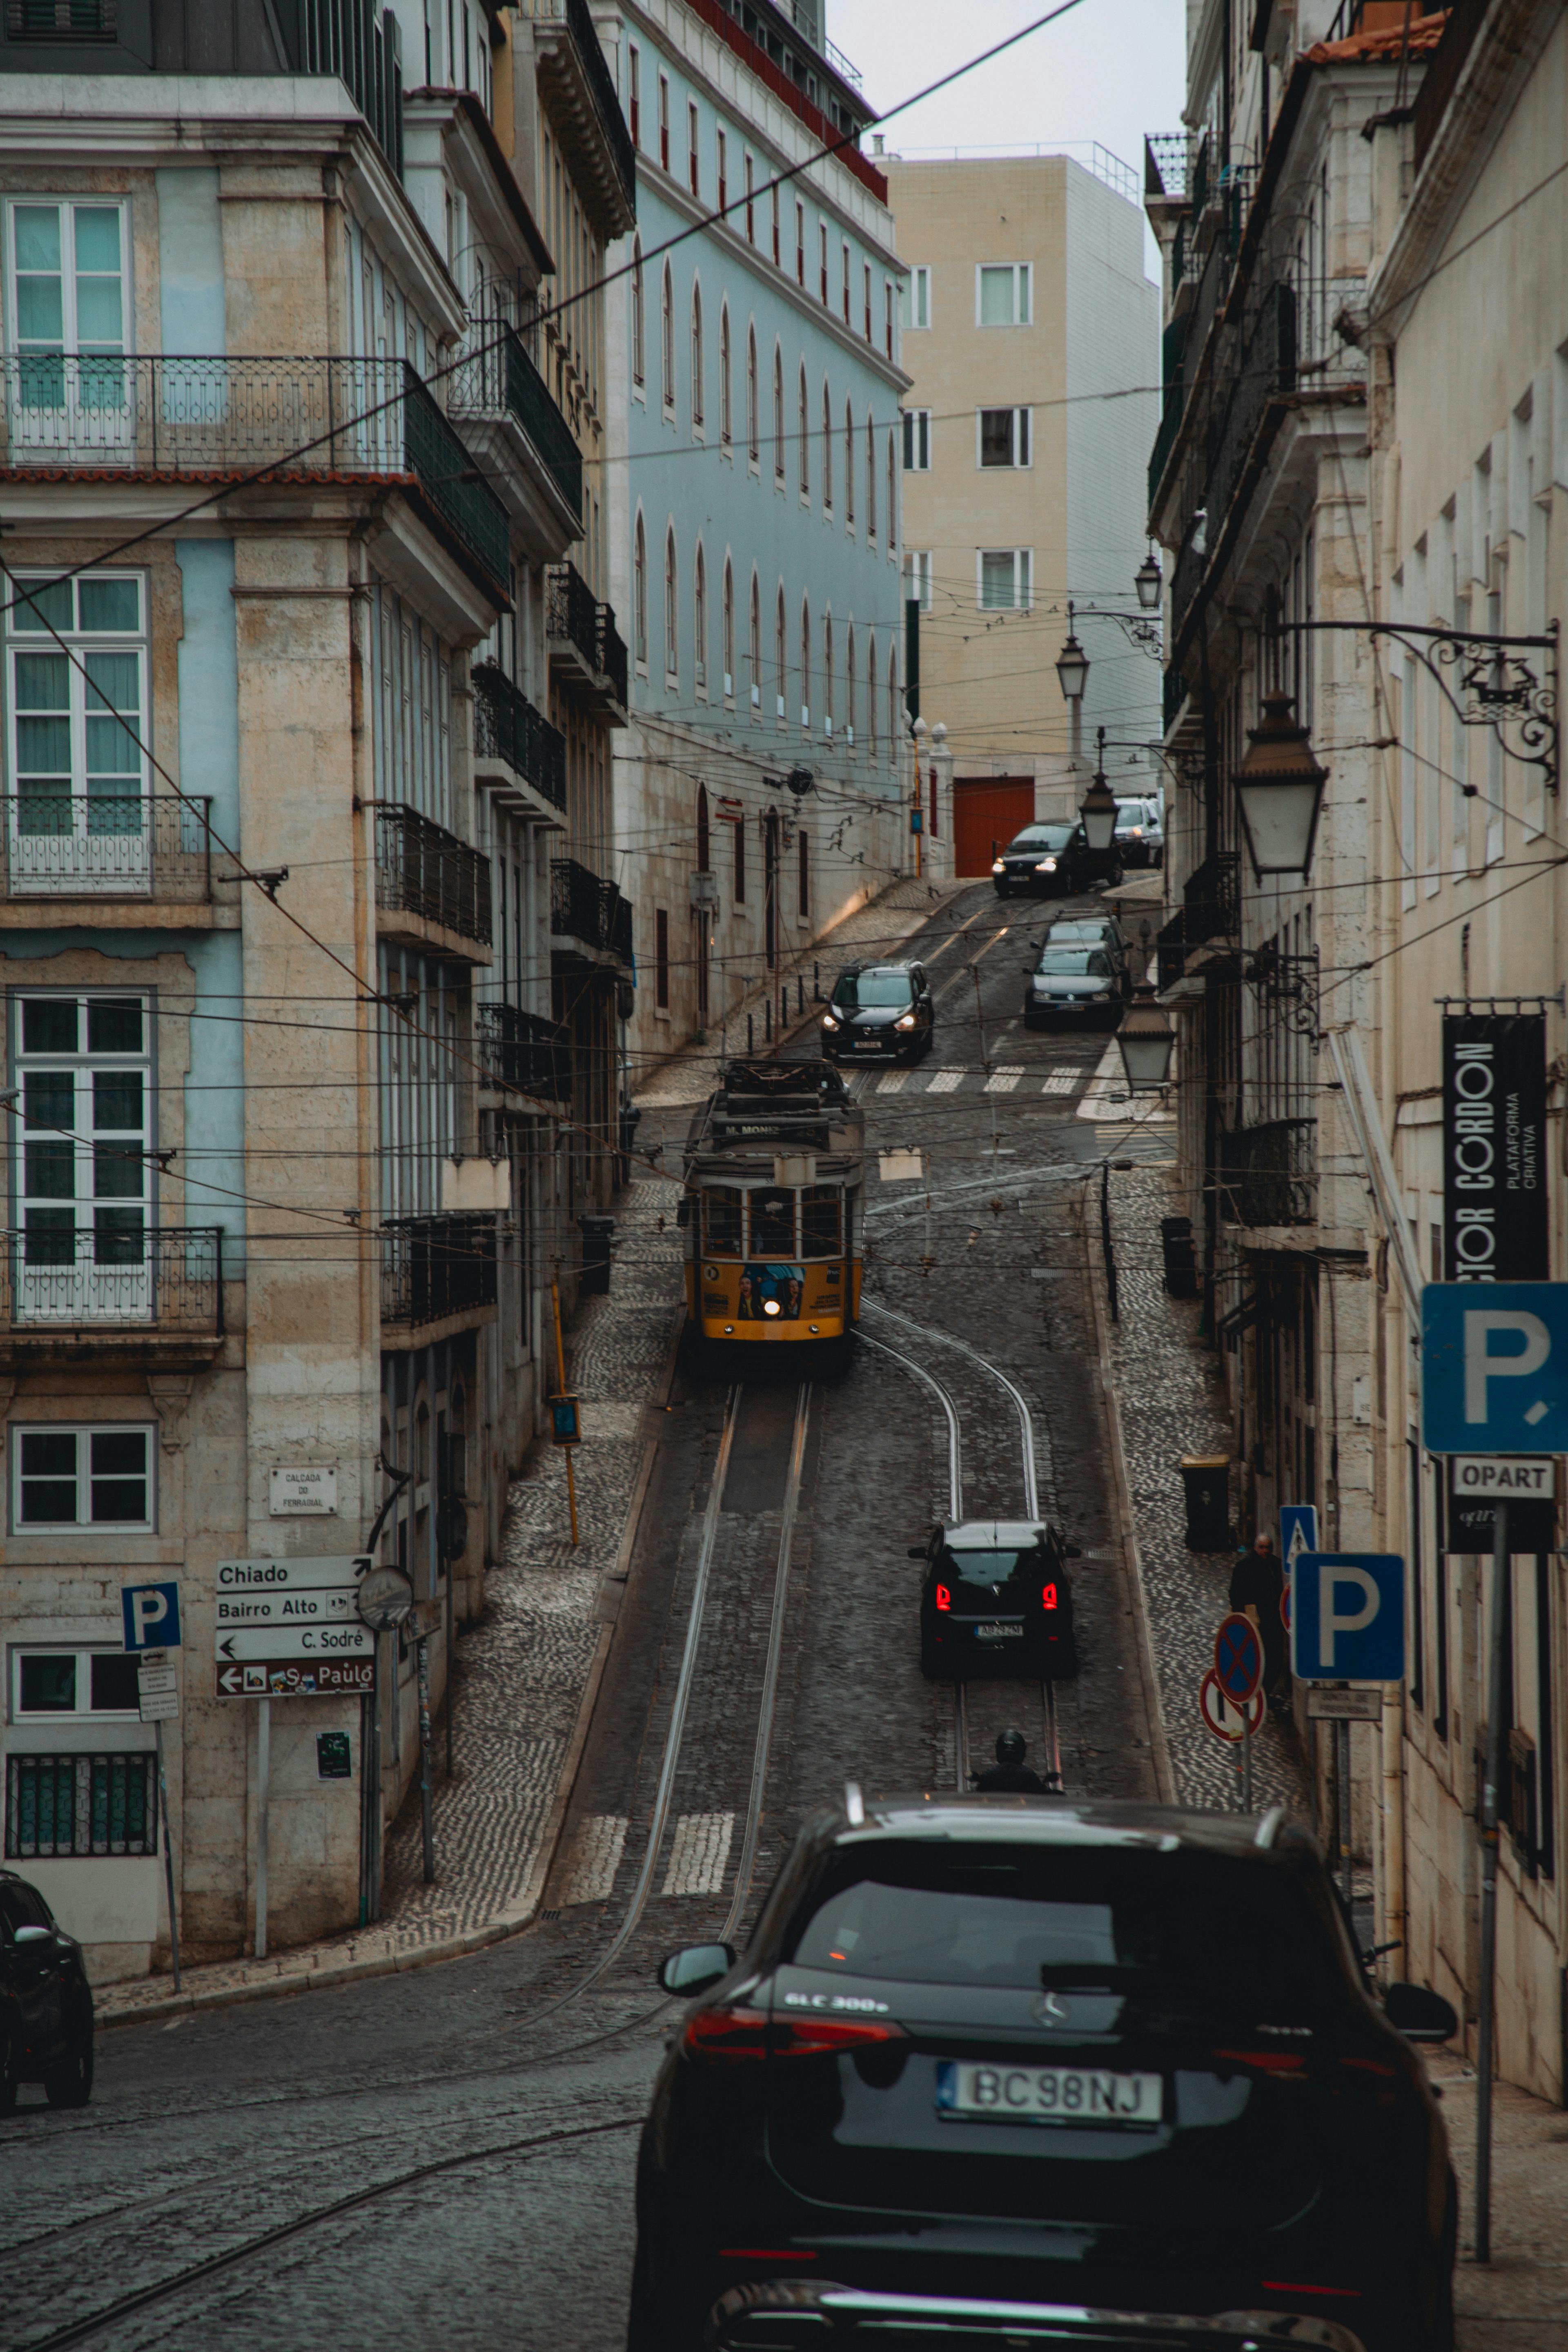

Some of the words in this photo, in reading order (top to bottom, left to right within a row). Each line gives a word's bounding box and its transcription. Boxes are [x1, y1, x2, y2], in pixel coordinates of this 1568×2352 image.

[1506, 1091, 1521, 1189] PLATAFORMA
[1522, 1124, 1537, 1190] CRIATIVA
[1463, 1310, 1551, 1423] P
[1462, 1465, 1547, 1488] OPART
[298, 1486, 308, 1494] DO
[283, 1499, 323, 1507] FERRAGIAL
[219, 1566, 287, 1584] Chiado
[132, 1590, 168, 1645] P
[218, 1603, 271, 1618] Bairro
[282, 1600, 317, 1615] Alto
[1319, 1566, 1381, 1667] P
[301, 1633, 316, 1649] C.
[321, 1629, 363, 1648] Sodré
[319, 1668, 372, 1684] Paulo
